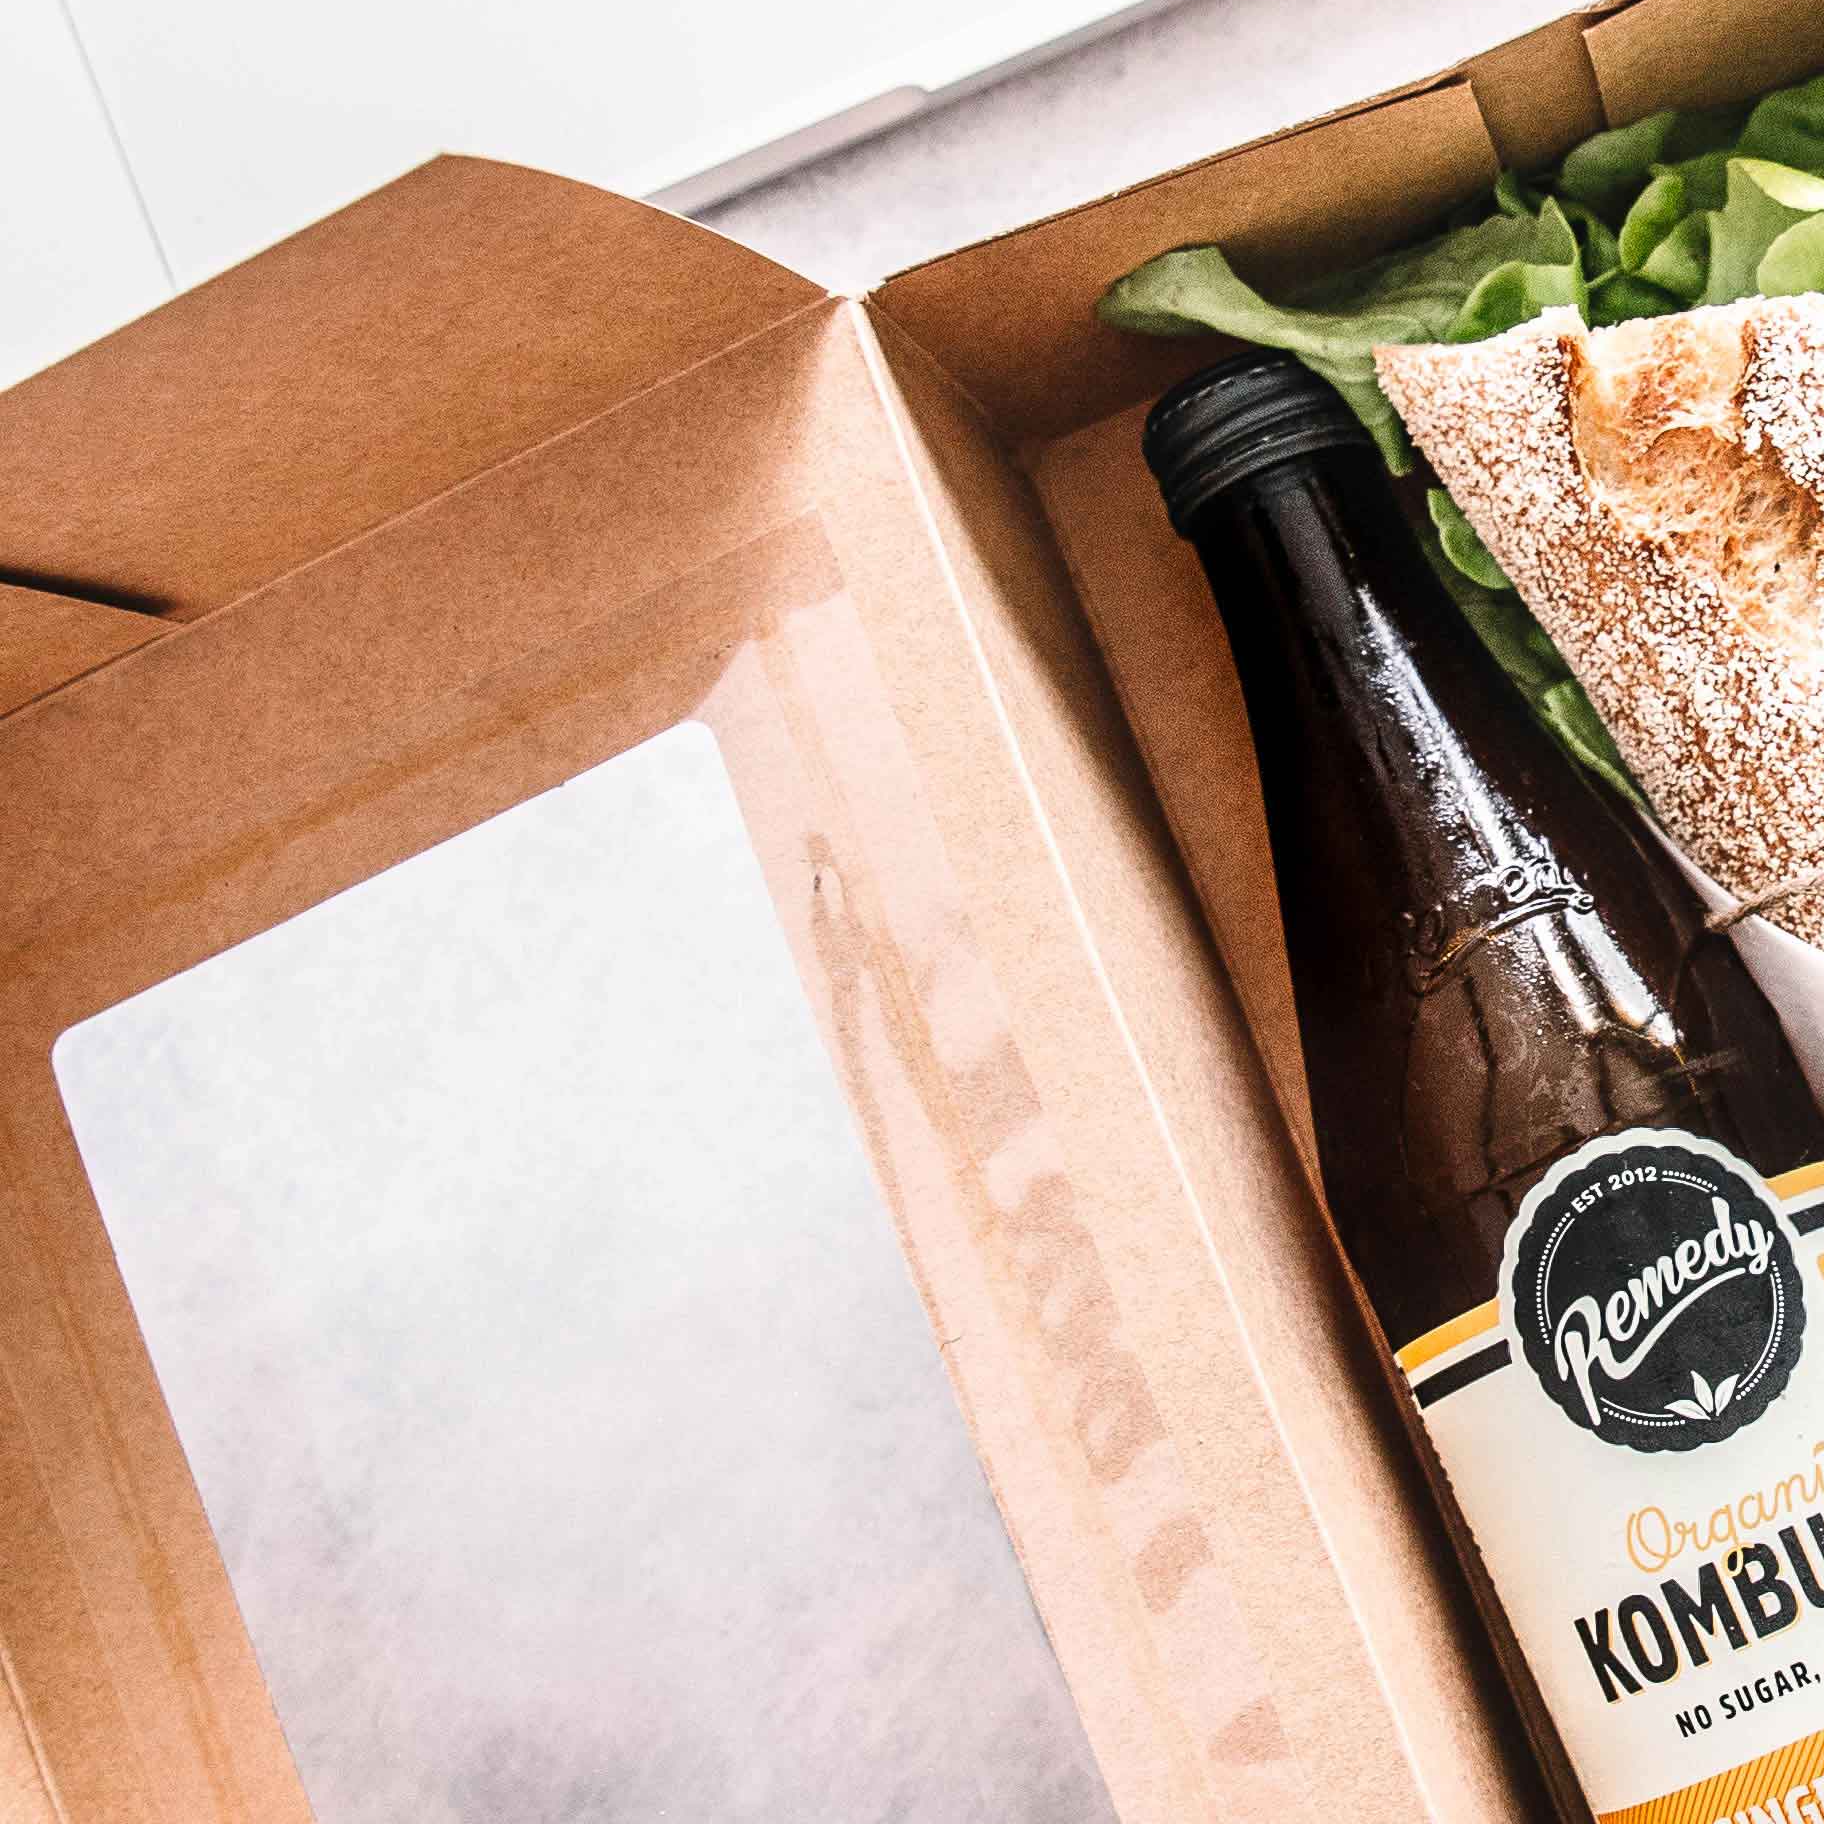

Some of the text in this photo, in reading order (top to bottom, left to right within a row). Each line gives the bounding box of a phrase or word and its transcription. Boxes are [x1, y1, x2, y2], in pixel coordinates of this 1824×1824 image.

[1571, 1166, 1657, 1213] EST 2012
[1555, 1197, 1774, 1426] Remedy
[1675, 1704, 1713, 1738] NO
[1720, 1661, 1821, 1719] SUGAR,
